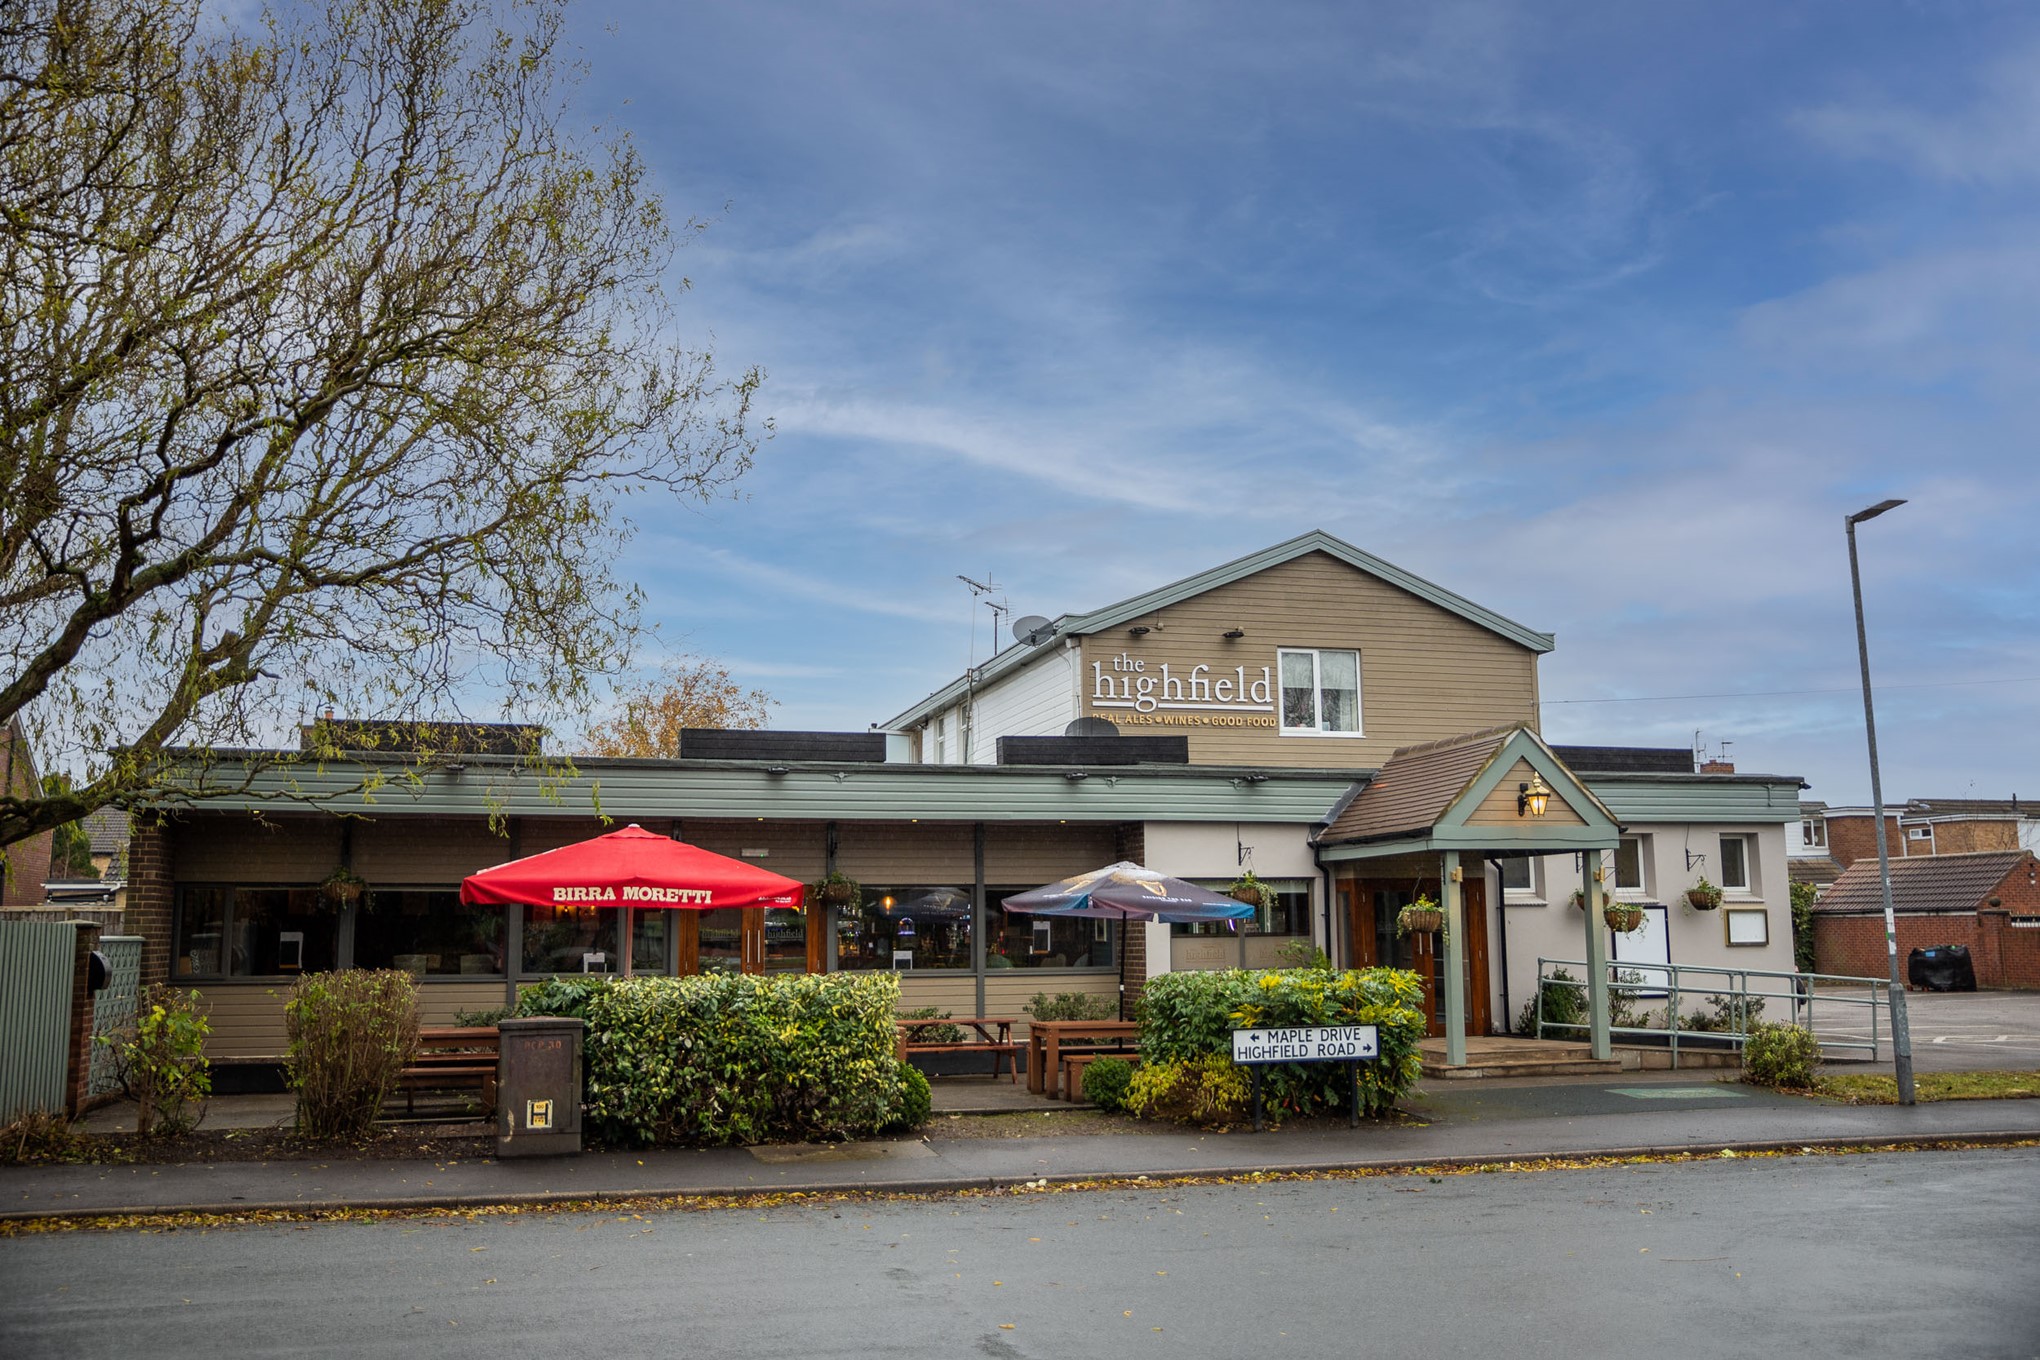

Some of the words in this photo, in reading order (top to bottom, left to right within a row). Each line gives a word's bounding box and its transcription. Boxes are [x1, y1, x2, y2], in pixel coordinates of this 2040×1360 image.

[1113, 652, 1145, 672] the
[1092, 660, 1274, 713] highfield
[1125, 714, 1153, 724] ALES
[1163, 715, 1201, 725] WINES
[1211, 716, 1243, 726] GOOD
[1247, 717, 1277, 727] FOOD
[553, 887, 616, 901] BIRRA
[622, 886, 713, 904] MORETTI
[1267, 1029, 1313, 1043] MAPLE
[1320, 1028, 1361, 1042] DRIVE
[1238, 1044, 1309, 1059] HIGHFIELD
[1317, 1043, 1356, 1056] ROAD
